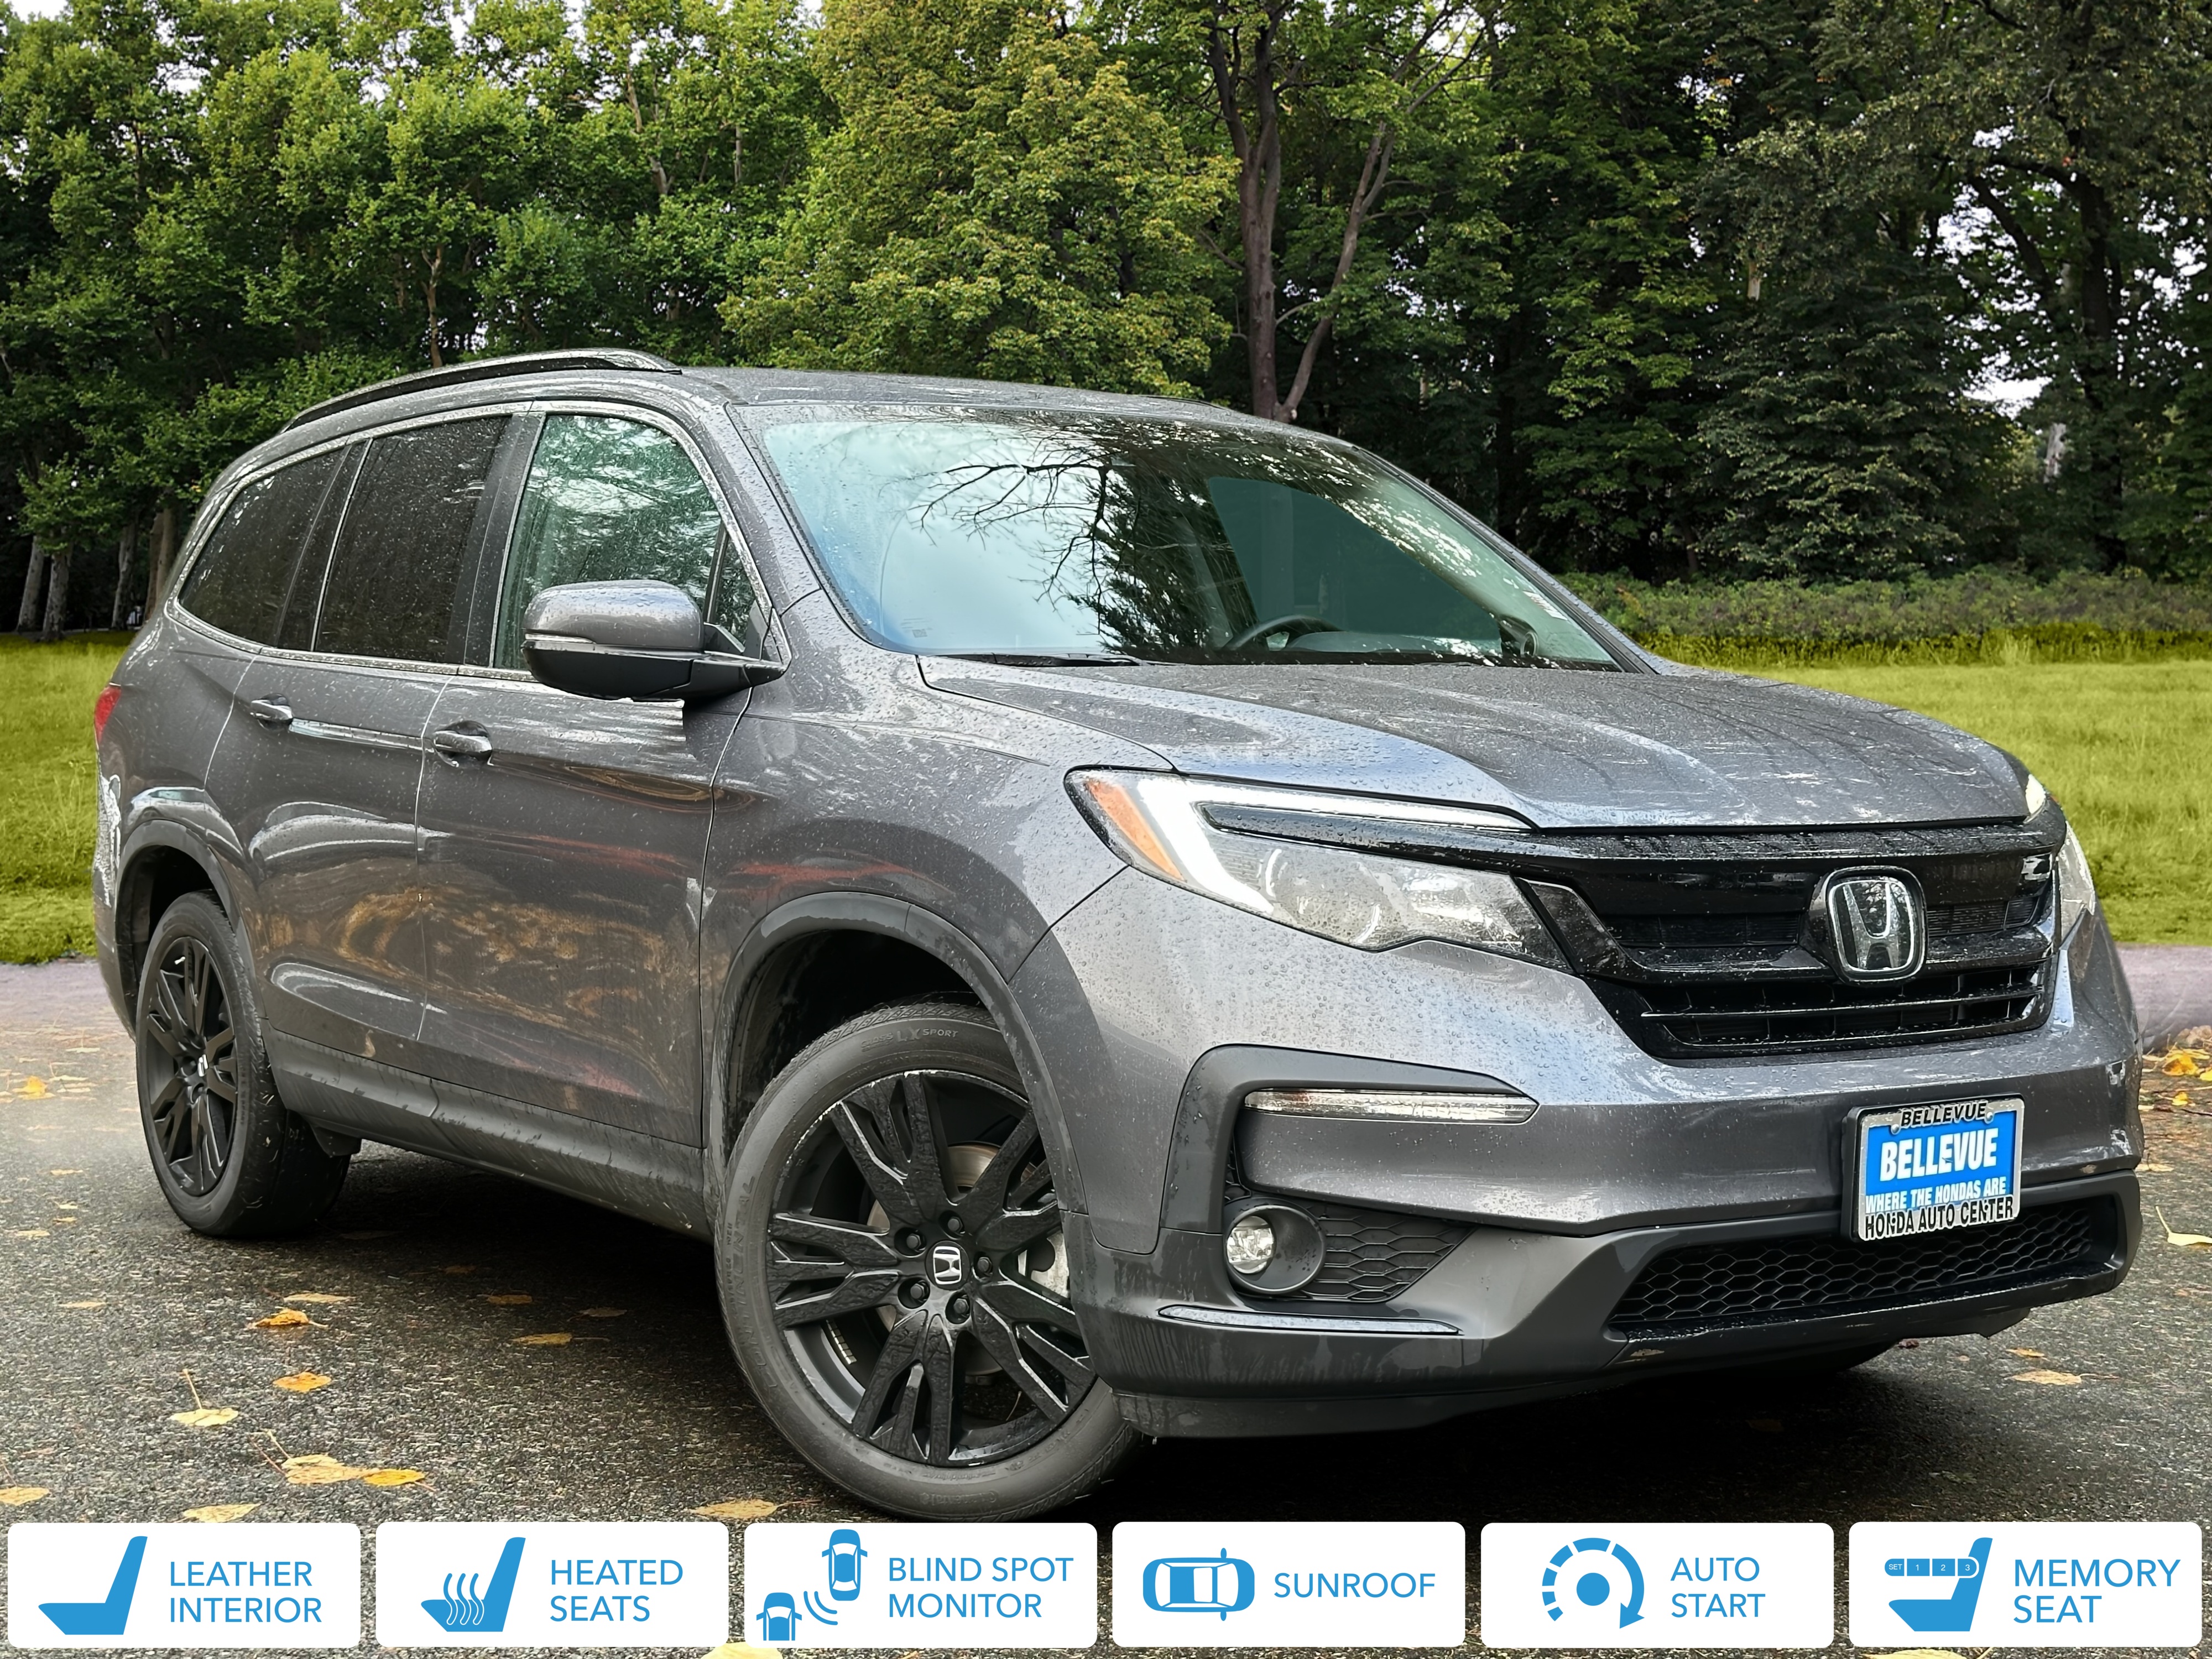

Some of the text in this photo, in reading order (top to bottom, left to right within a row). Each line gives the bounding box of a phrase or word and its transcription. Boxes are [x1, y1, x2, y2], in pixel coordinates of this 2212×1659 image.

[896, 1028, 921, 1042] LX
[922, 1029, 959, 1037] SPORT
[1901, 1102, 1987, 1126] BELLEVUE
[1880, 1128, 1999, 1182] BELLEVUE
[1865, 1176, 2007, 1213] WHERE THE HONDAS ARE
[1865, 1196, 2013, 1239] HONDA AUTO CENTER
